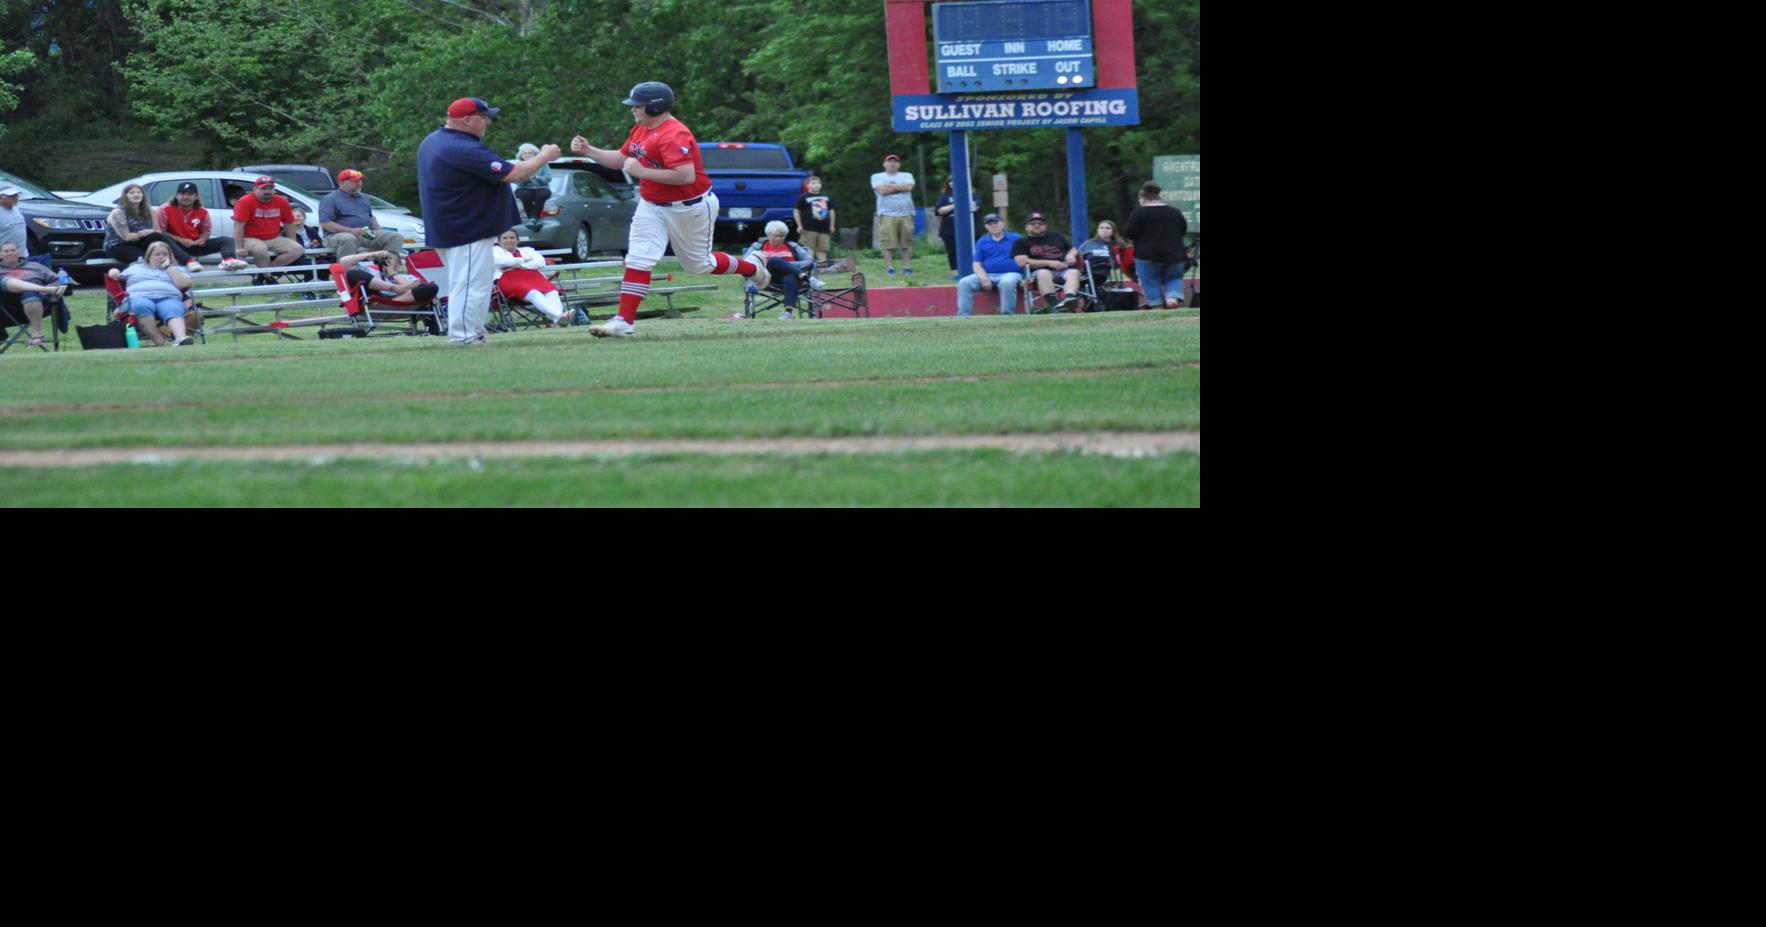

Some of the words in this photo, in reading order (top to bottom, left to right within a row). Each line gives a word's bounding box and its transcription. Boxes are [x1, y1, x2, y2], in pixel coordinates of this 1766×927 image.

[941, 43, 982, 56] GUEST
[1004, 42, 1025, 54] INN
[1047, 40, 1082, 52] HOME
[947, 65, 977, 78] BALL
[992, 62, 1038, 76] STRIKE
[1055, 61, 1080, 73] OUT
[955, 94, 1048, 102] SPONSORED
[905, 103, 1015, 120] SULLIVAN
[1022, 100, 1126, 117] ROOFING
[920, 121, 942, 129] CLASS
[1006, 118, 1040, 126] PROJECT
